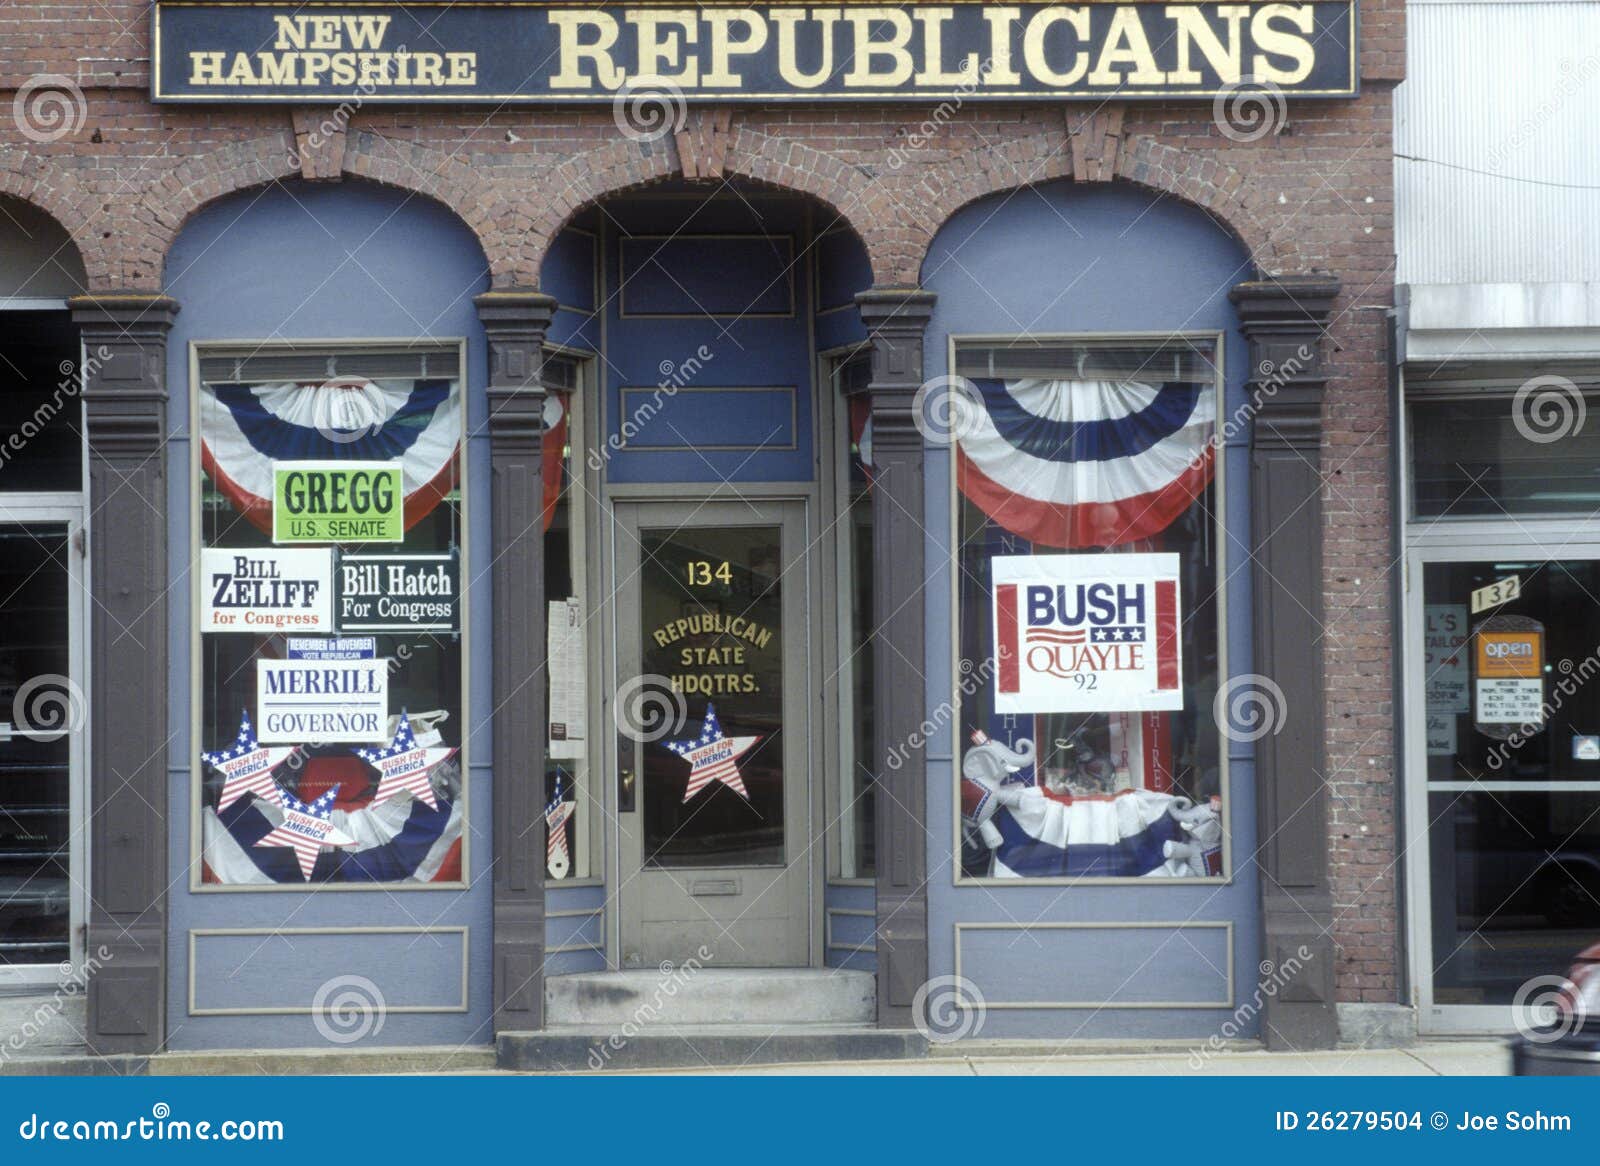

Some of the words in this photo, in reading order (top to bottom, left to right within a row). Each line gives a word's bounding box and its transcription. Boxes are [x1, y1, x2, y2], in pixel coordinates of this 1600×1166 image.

[274, 15, 391, 50] NEW
[547, 3, 1315, 91] REPUBLICANS
[189, 51, 477, 87] HAMPSHIRE
[284, 471, 393, 515] GREGG
[291, 521, 320, 537] U.S.
[328, 521, 386, 537] SENATE
[341, 564, 380, 596] Bill
[387, 564, 452, 596] Hatch
[688, 561, 733, 586] 134
[212, 573, 319, 608] ZELIFF
[1476, 579, 1516, 608] 132
[341, 598, 371, 617] For
[378, 597, 452, 621] Congress
[1026, 583, 1146, 626] BUSH
[213, 611, 236, 624] for
[245, 611, 319, 627] Congress
[653, 614, 772, 649] REPUBLICAN
[336, 638, 373, 651] NOVEMBER
[1485, 641, 1533, 659] open
[302, 652, 319, 660] VOTE
[320, 652, 361, 660] REPUBLICAN
[681, 648, 745, 666] STATE
[1026, 644, 1145, 679] QUAYLE
[264, 669, 382, 695] MERRILL
[671, 673, 760, 697] HDQTRS.
[1074, 673, 1098, 690] 92
[267, 712, 379, 734] GOVERNOR
[381, 757, 407, 770] BUSH
[408, 750, 427, 763] FOR
[691, 746, 716, 761] BUSH
[716, 739, 735, 752] FOR
[694, 749, 733, 769] AMERICA
[225, 759, 250, 773] BUSH
[252, 750, 270, 763] FOR
[228, 760, 269, 780] AMERICA
[384, 759, 425, 779] AMERICA
[283, 821, 326, 841] AMERICA
[287, 812, 313, 828] BUSH
[313, 820, 334, 834] FOR
